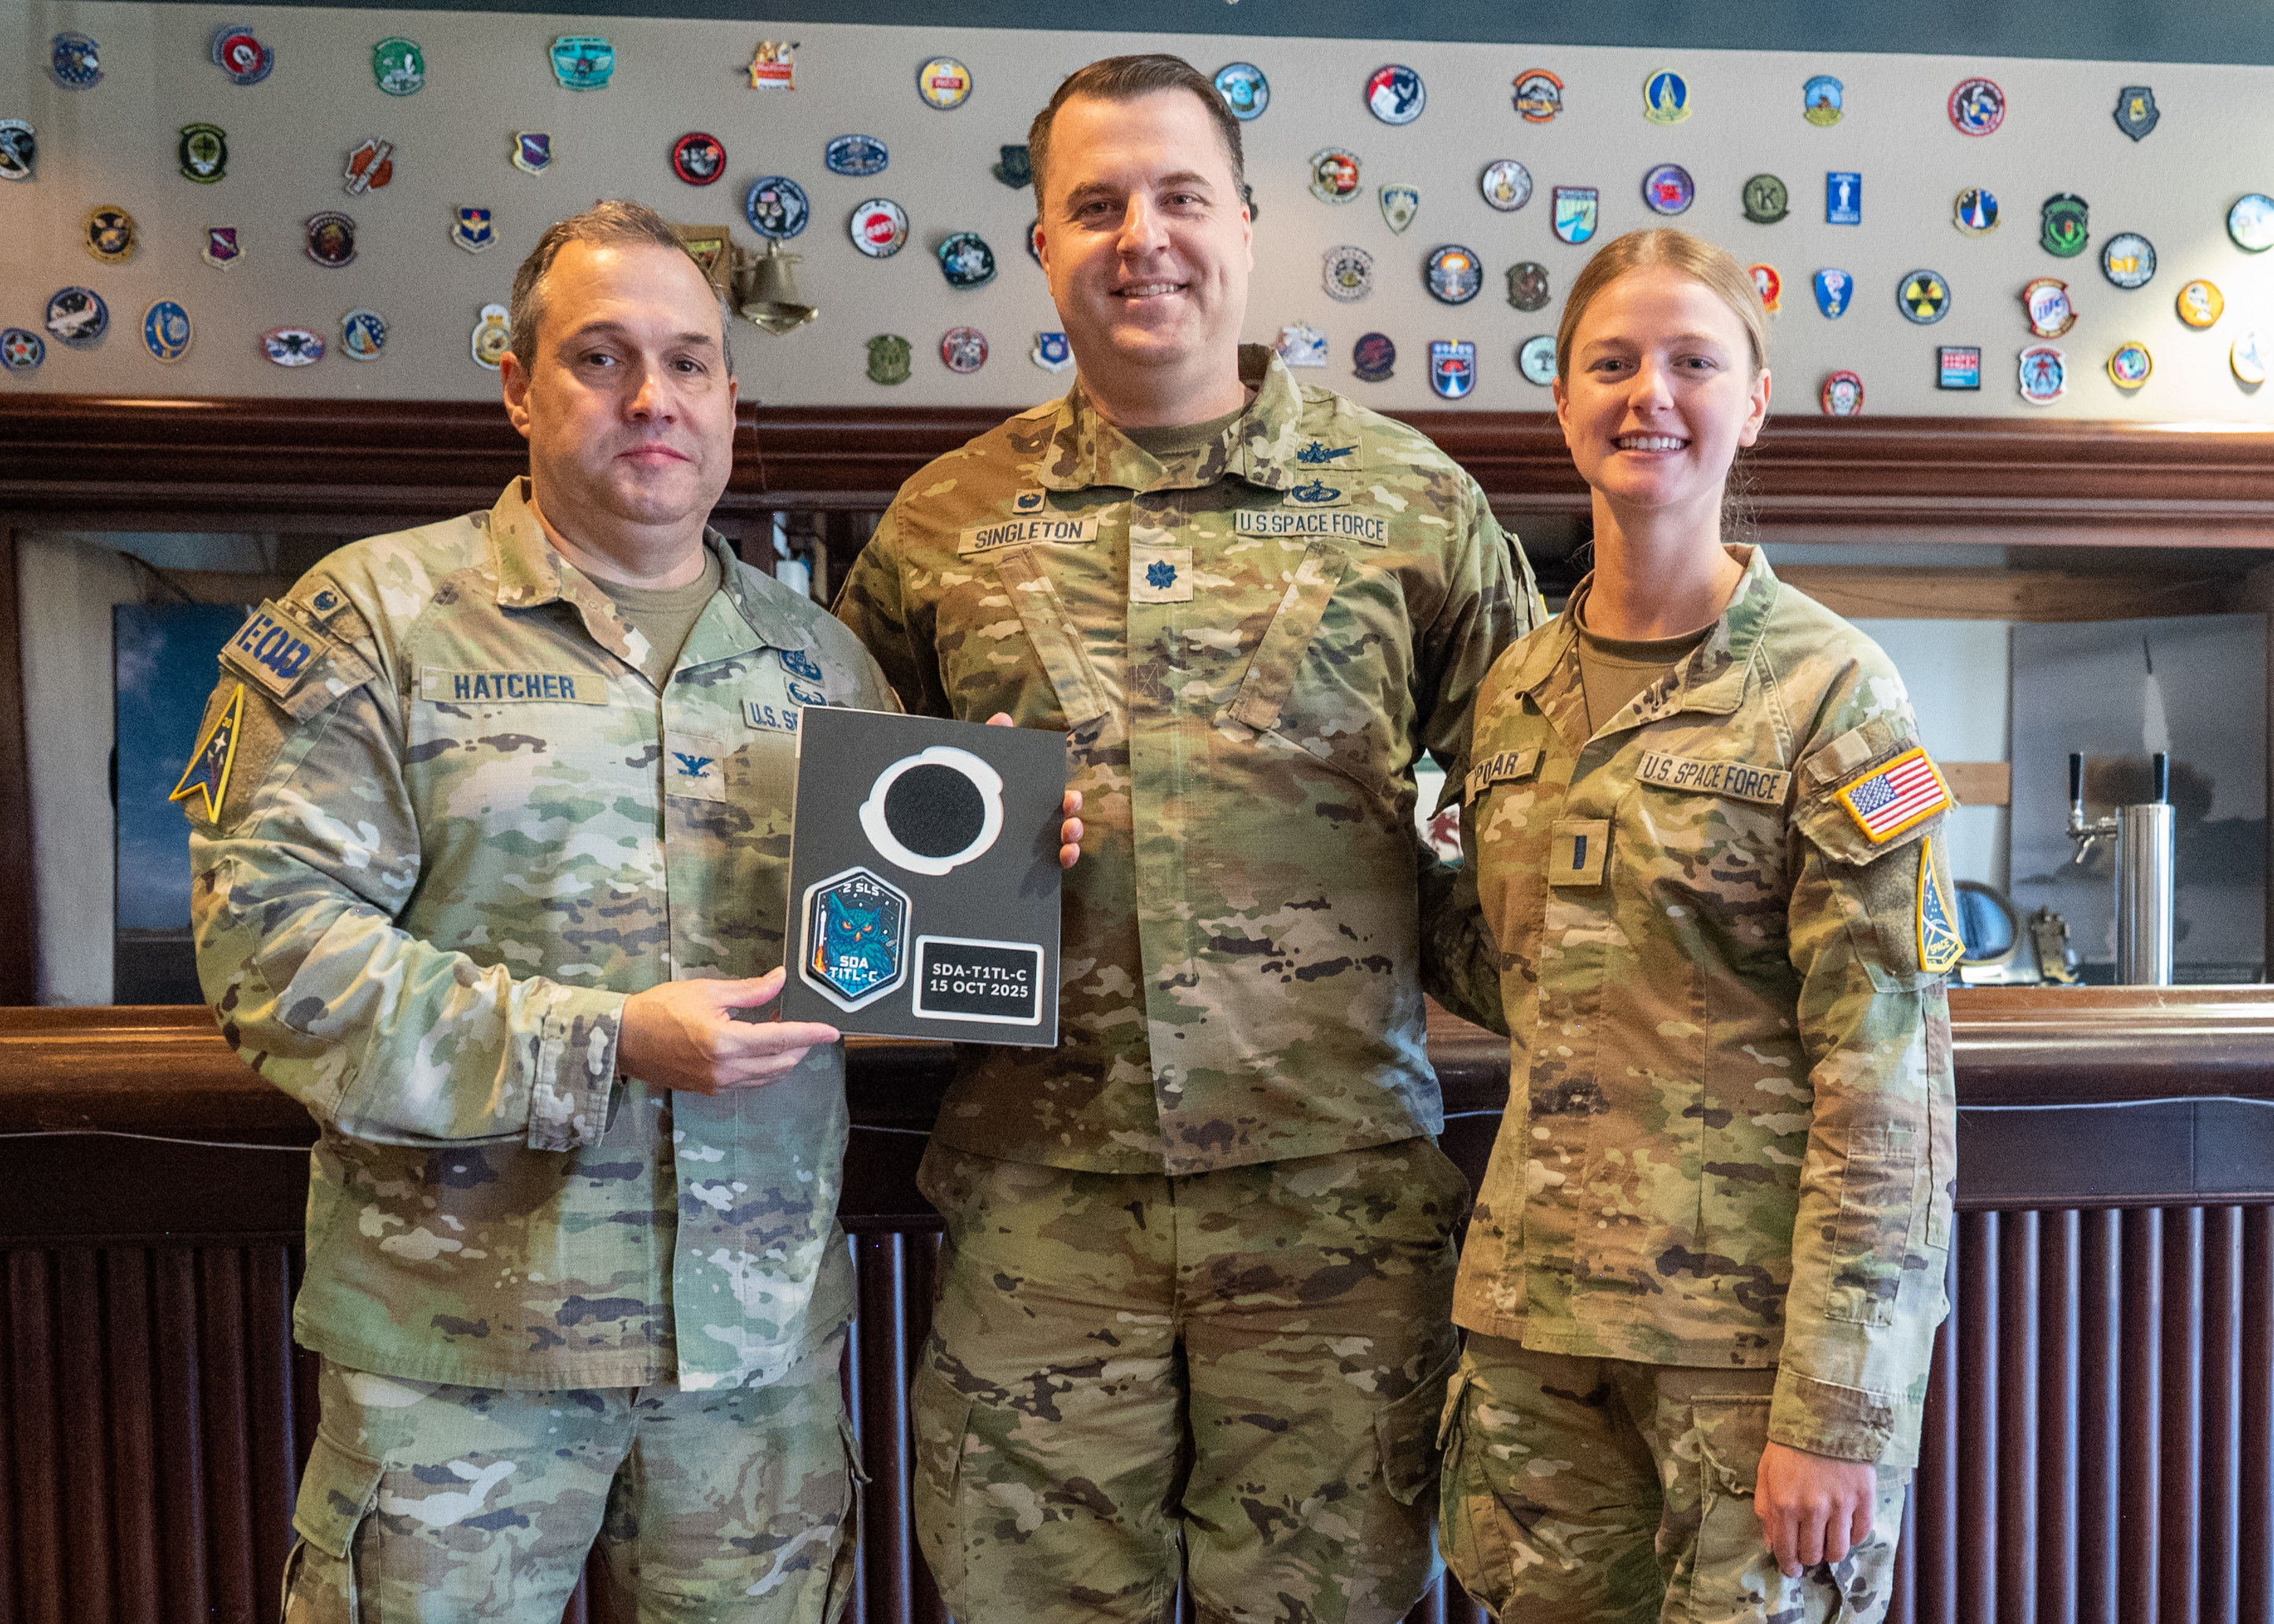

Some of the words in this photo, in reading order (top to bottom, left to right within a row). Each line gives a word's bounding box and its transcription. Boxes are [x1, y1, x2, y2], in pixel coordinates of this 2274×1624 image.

[865, 220, 896, 238] easy
[975, 521, 1083, 549] SINGLETON
[1272, 514, 1328, 533] SPACE
[1332, 513, 1385, 542] FORCE
[236, 613, 310, 678] EOD
[454, 673, 576, 699] HATCHER
[222, 715, 233, 729] 30
[749, 702, 781, 728] U.S.
[1643, 755, 1673, 781] U.S.
[1673, 762, 1725, 788] SPACE
[1722, 766, 1781, 799] FORCE
[843, 883, 851, 894] 2
[855, 883, 880, 896] SLS
[1929, 938, 1950, 956] SPACE
[839, 955, 869, 968] SDA
[931, 962, 1027, 982] SDA-T1TL-C
[930, 979, 949, 992] 15
[953, 980, 986, 995] OCT
[990, 983, 1029, 998] 2025
